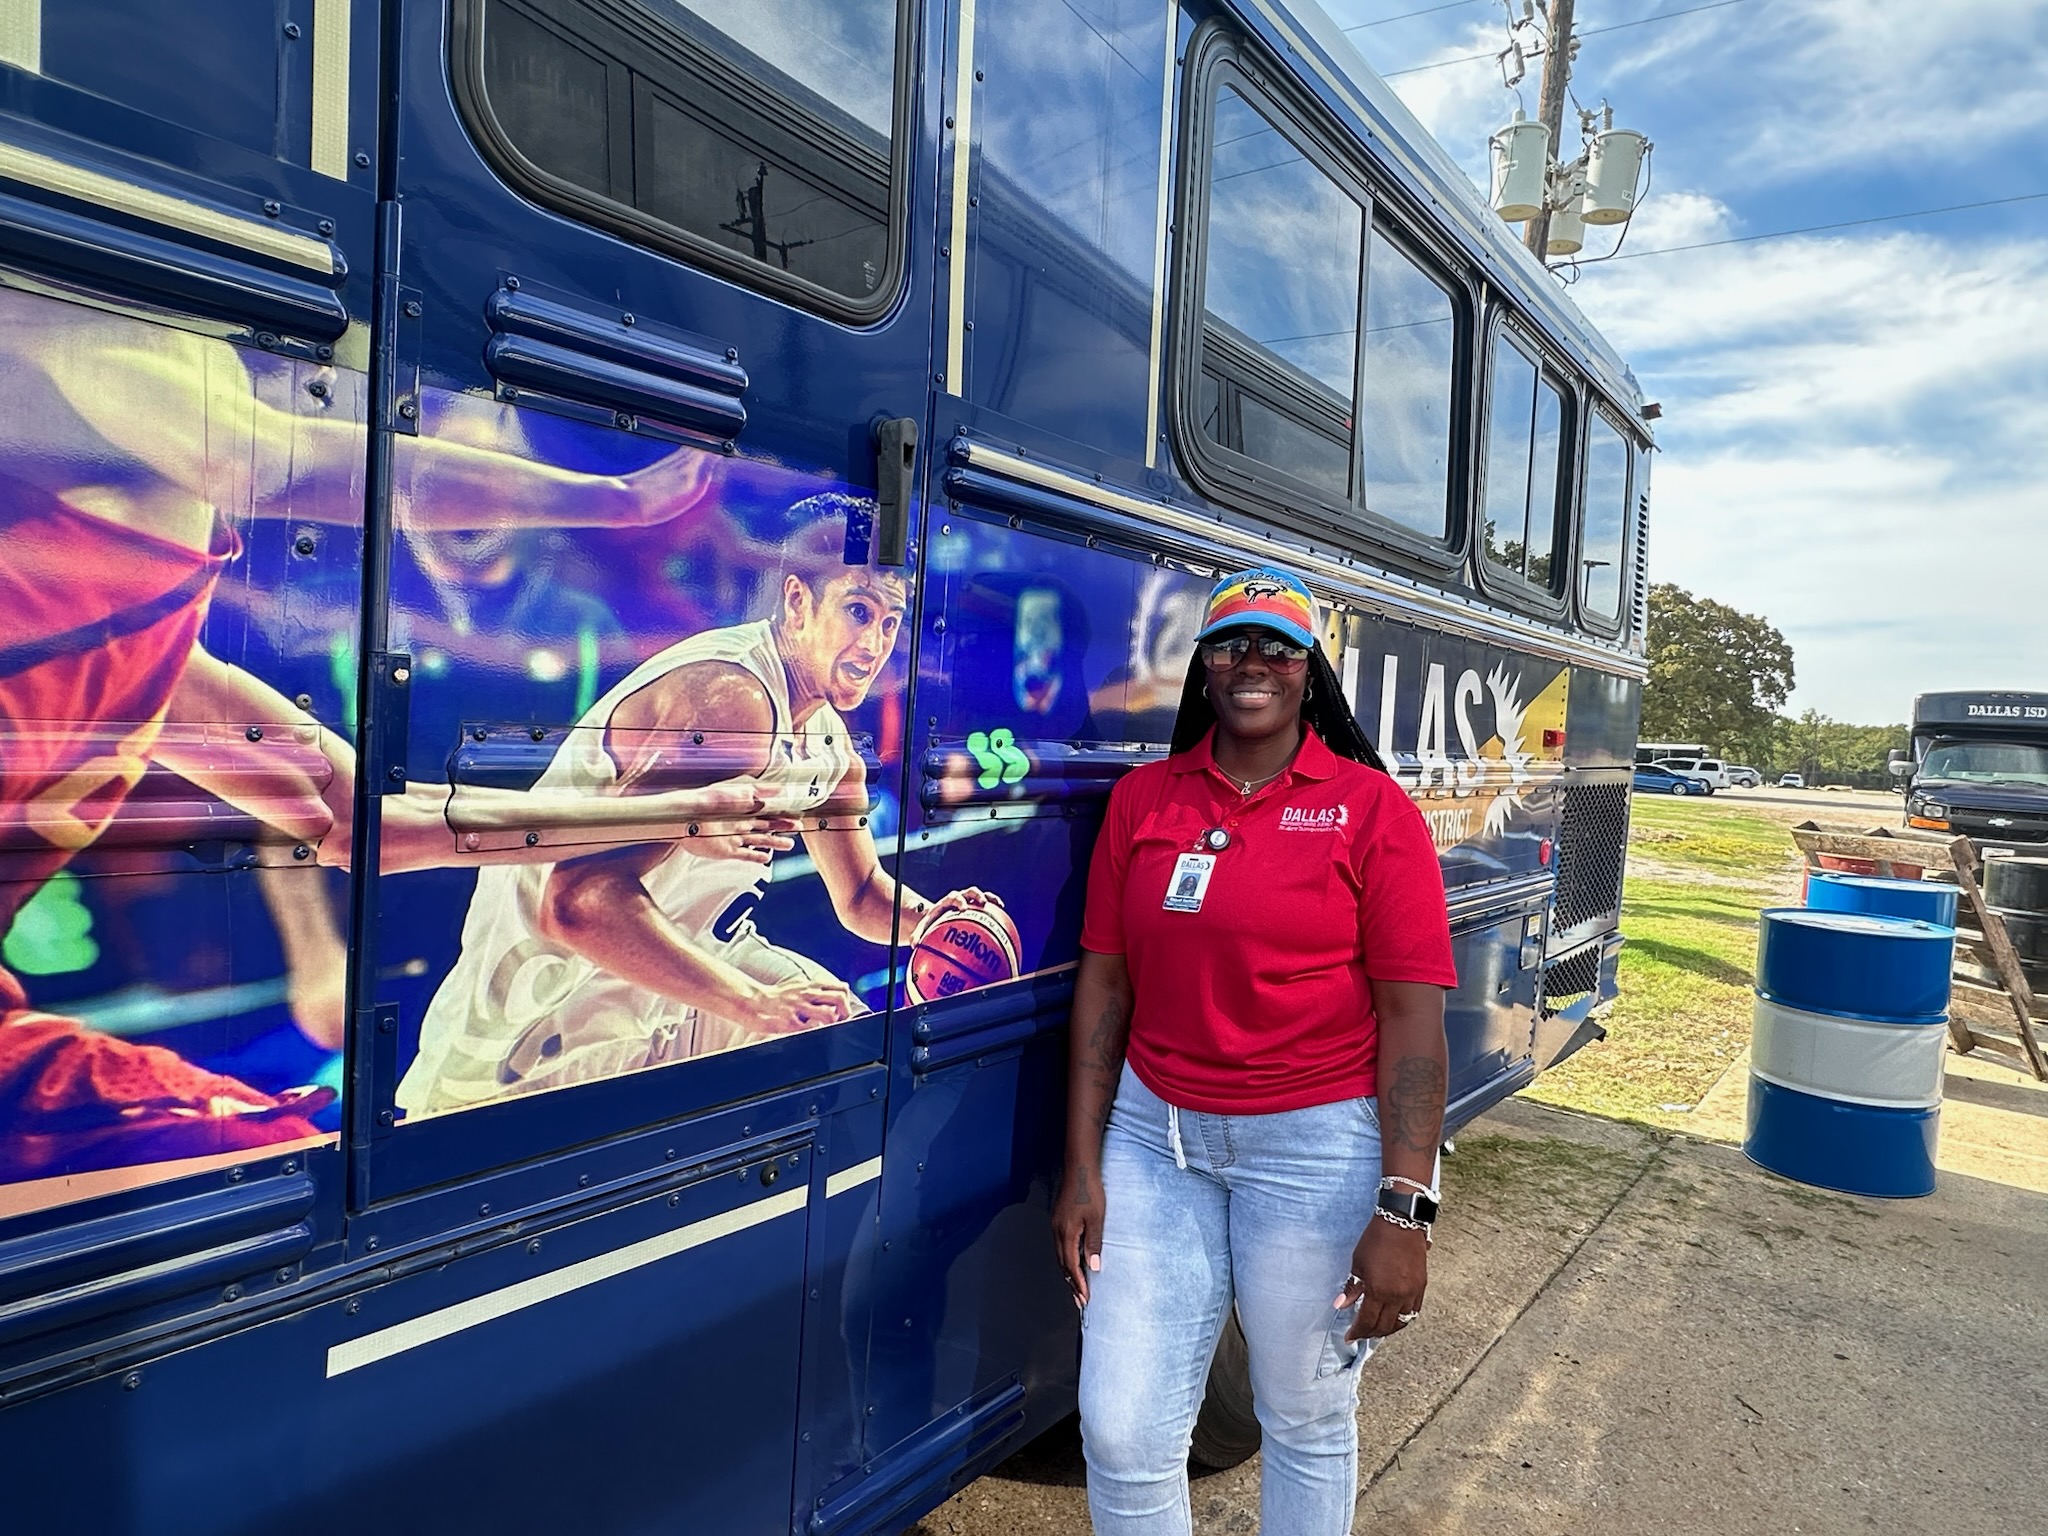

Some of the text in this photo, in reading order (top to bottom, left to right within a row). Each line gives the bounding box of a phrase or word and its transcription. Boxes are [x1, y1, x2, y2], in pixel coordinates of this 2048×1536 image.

[1968, 704, 2047, 718] DALLAS ISD
[1281, 806, 1336, 822] DALLAS
[1421, 808, 1473, 841] ISTRICT
[1181, 860, 1205, 870] DALLAS
